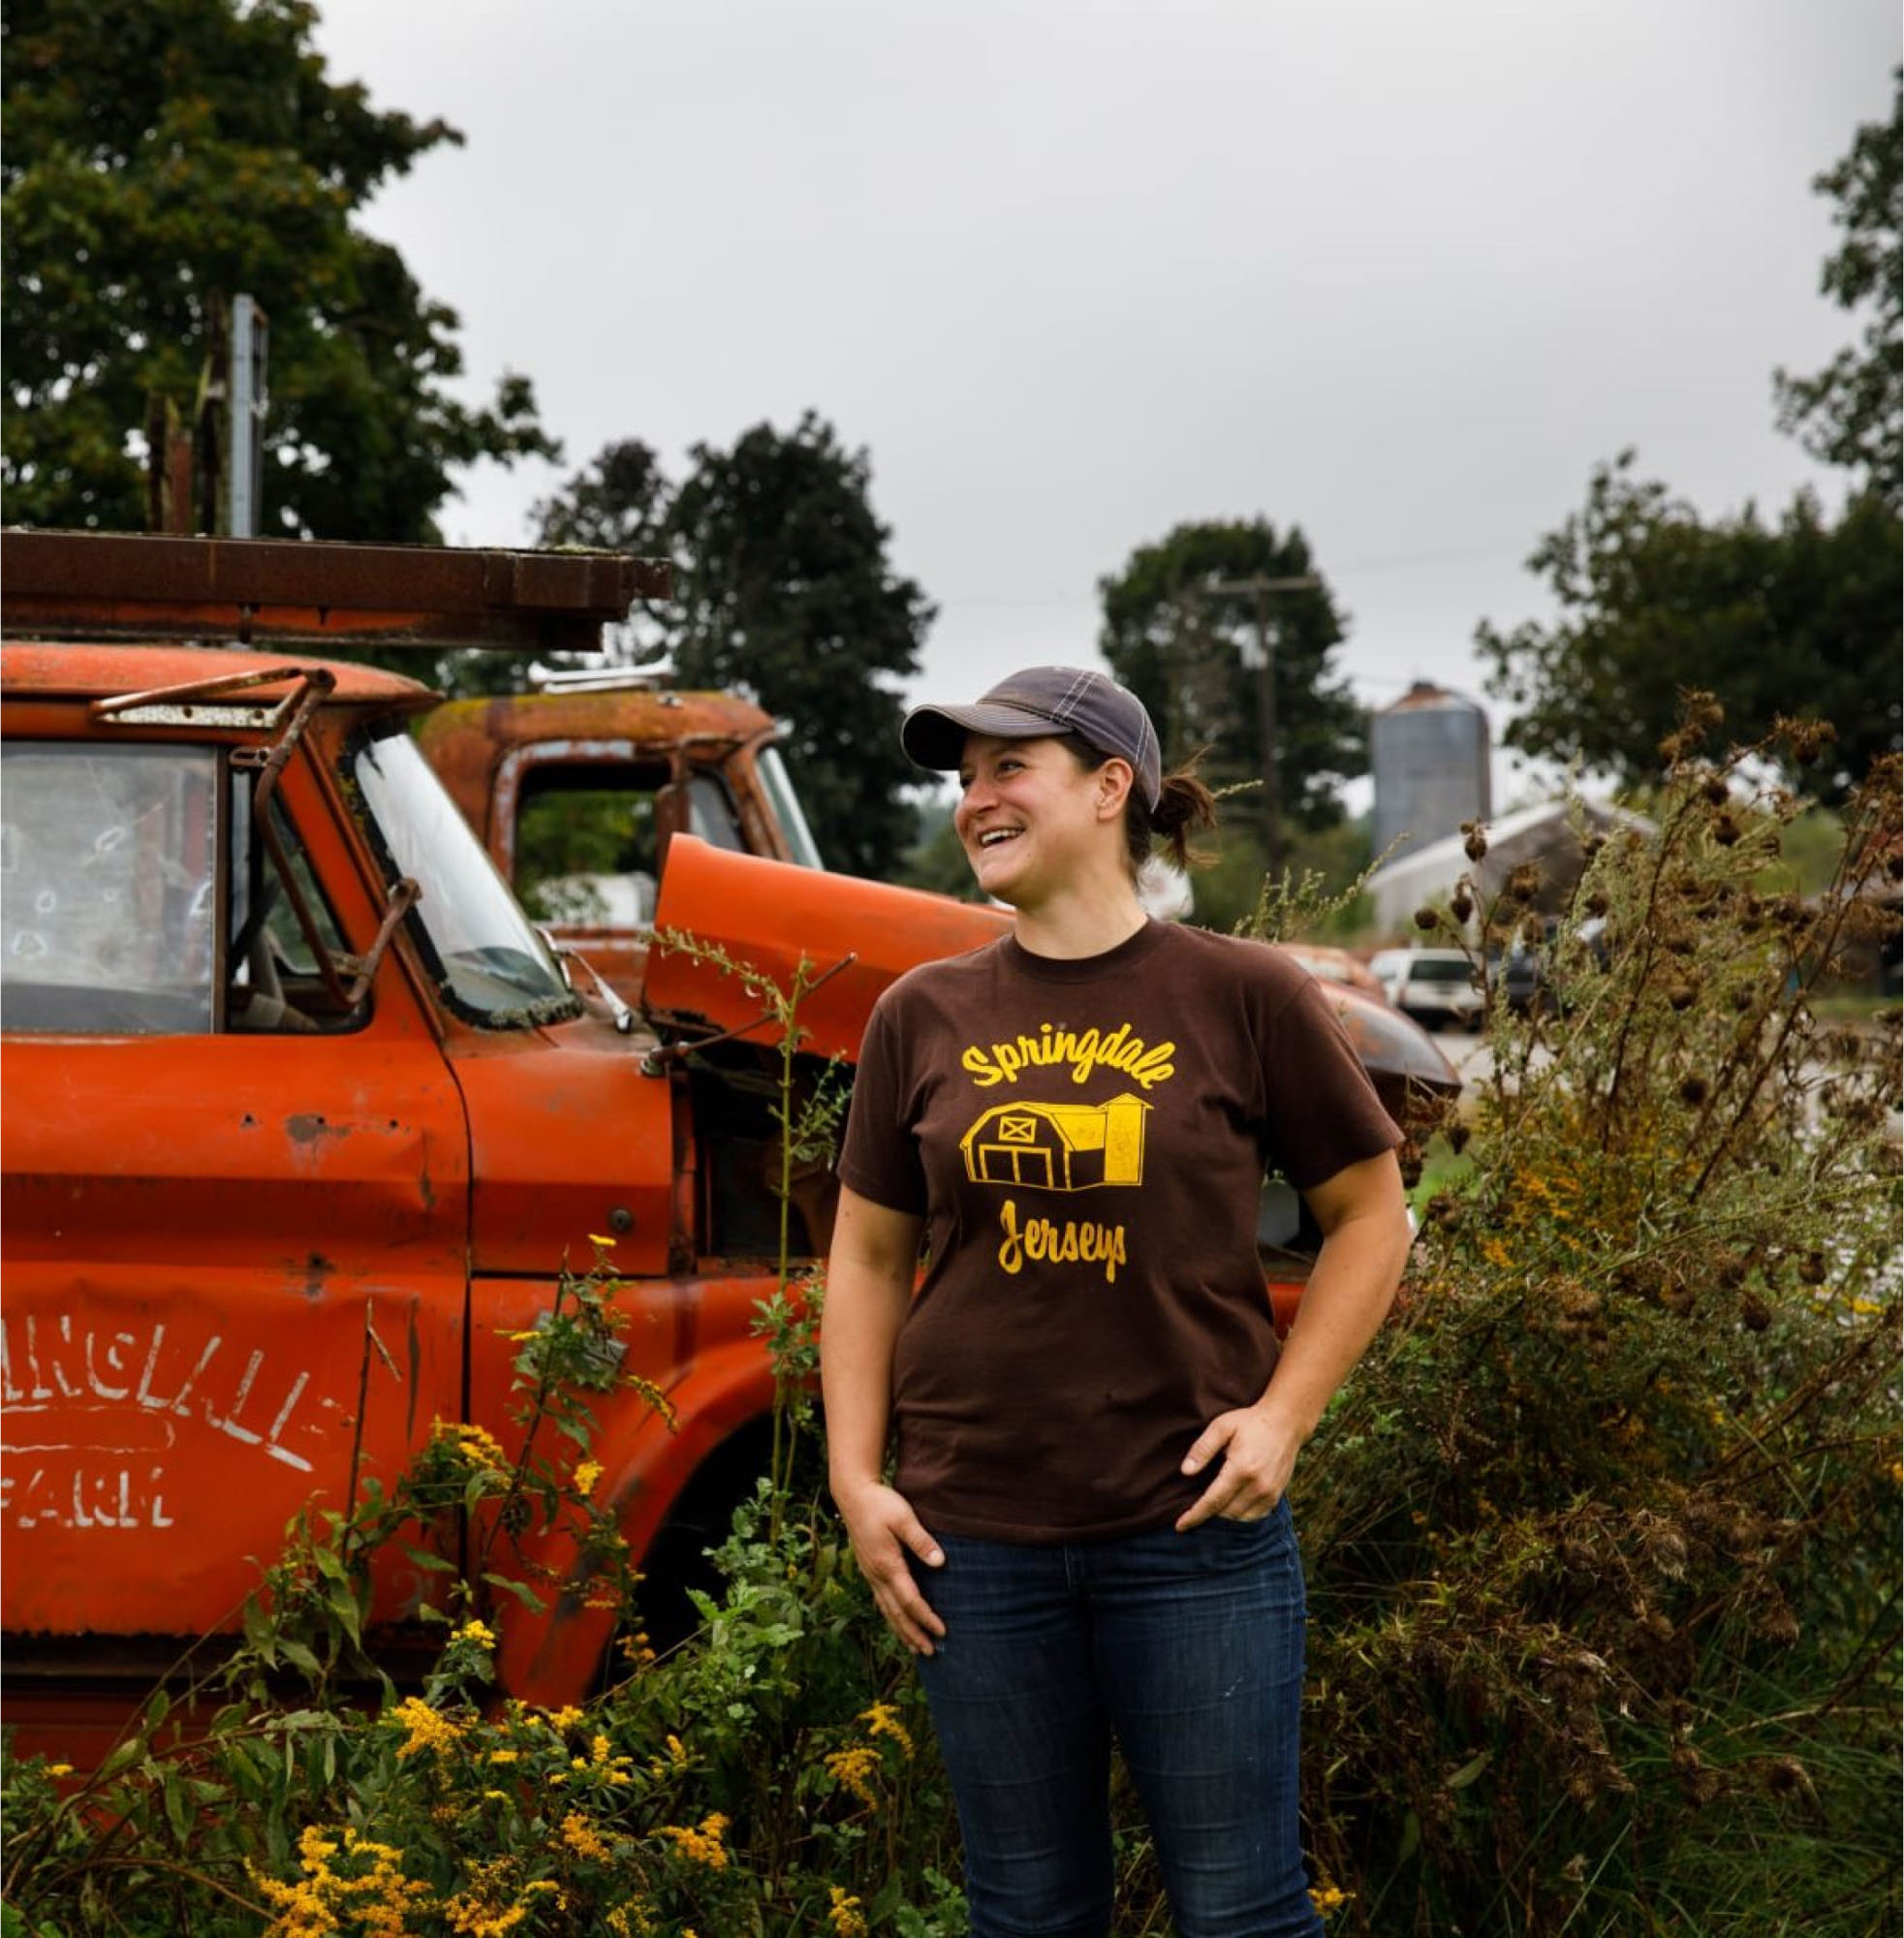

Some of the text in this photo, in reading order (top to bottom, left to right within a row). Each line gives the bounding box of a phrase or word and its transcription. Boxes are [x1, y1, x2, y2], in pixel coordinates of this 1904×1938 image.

[961, 1022, 1175, 1089] Springdale
[998, 1199, 1127, 1283] Jerseys
[2, 1465, 174, 1529] ARM
